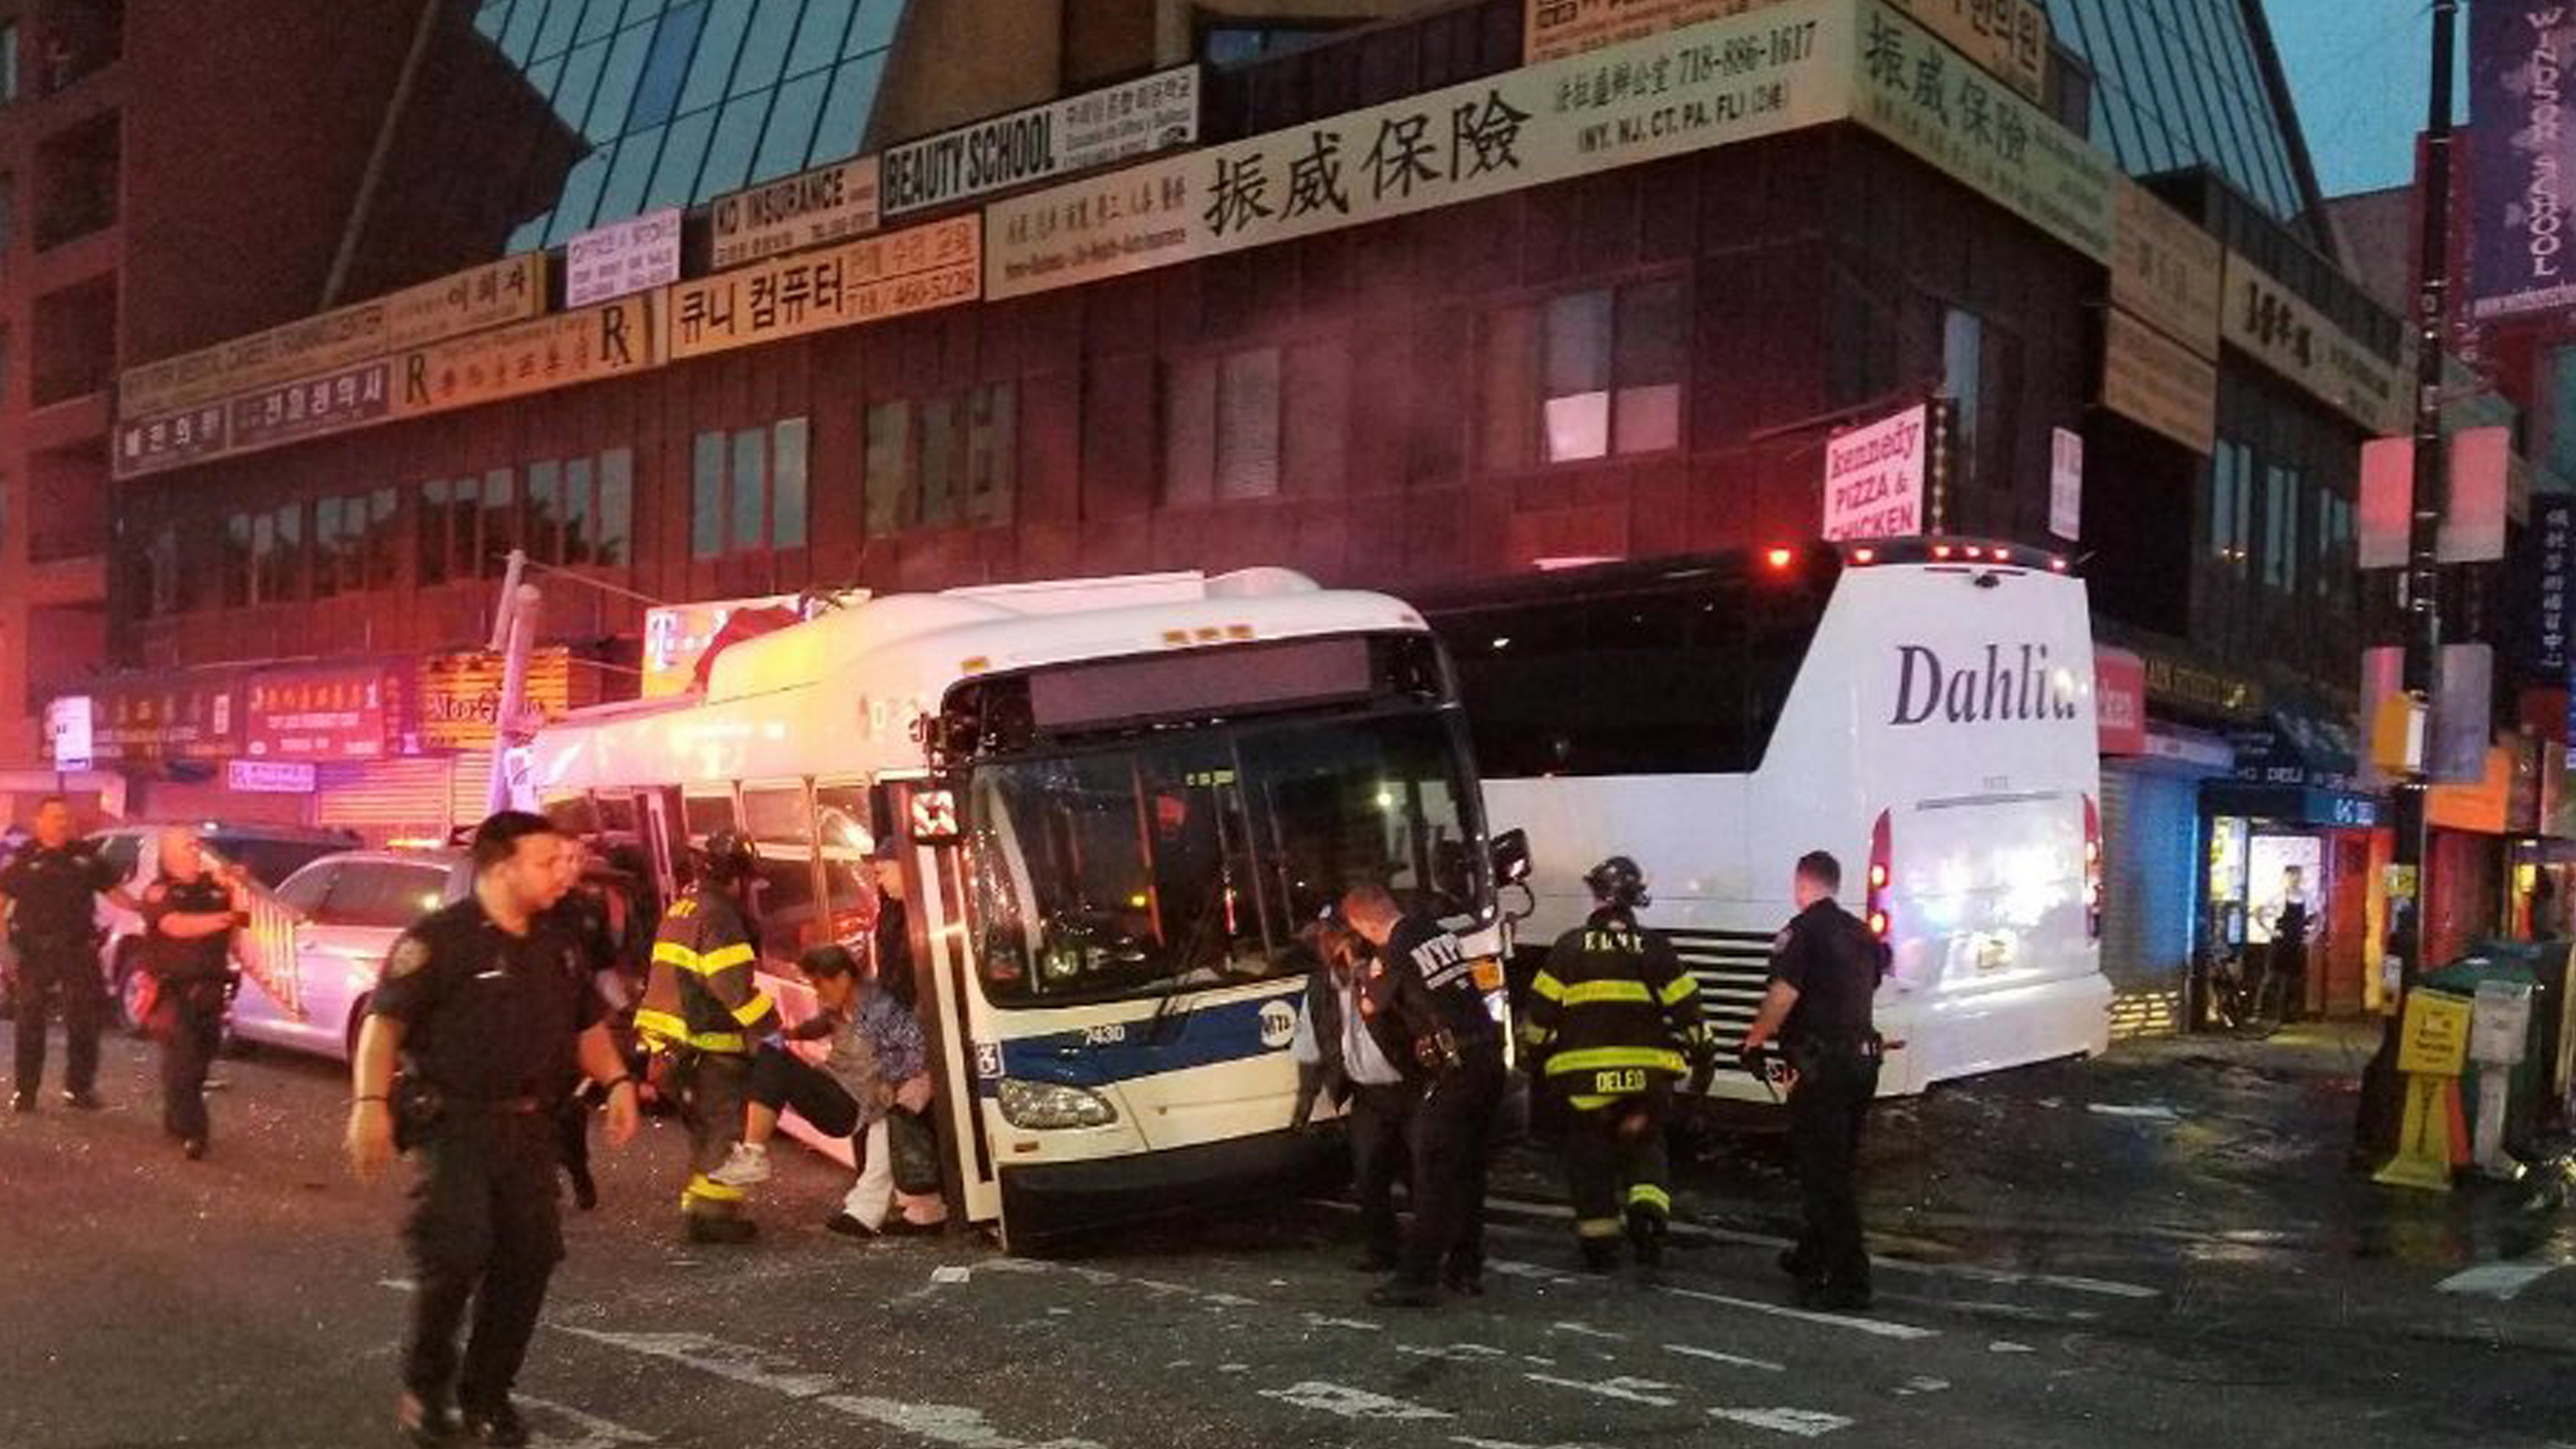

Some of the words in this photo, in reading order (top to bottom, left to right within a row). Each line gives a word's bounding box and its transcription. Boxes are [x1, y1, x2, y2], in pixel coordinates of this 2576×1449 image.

[885, 144, 965, 210] BEAUTY
[968, 109, 1056, 190] SCHOOL
[1203, 89, 1532, 237] 振威保險
[2530, 157, 2562, 276] SCHOOL
[681, 281, 736, 345] 큐니
[750, 256, 843, 333] 컴퓨터
[1835, 471, 1889, 513] PIZZA
[1888, 643, 2077, 726] Dahlia
